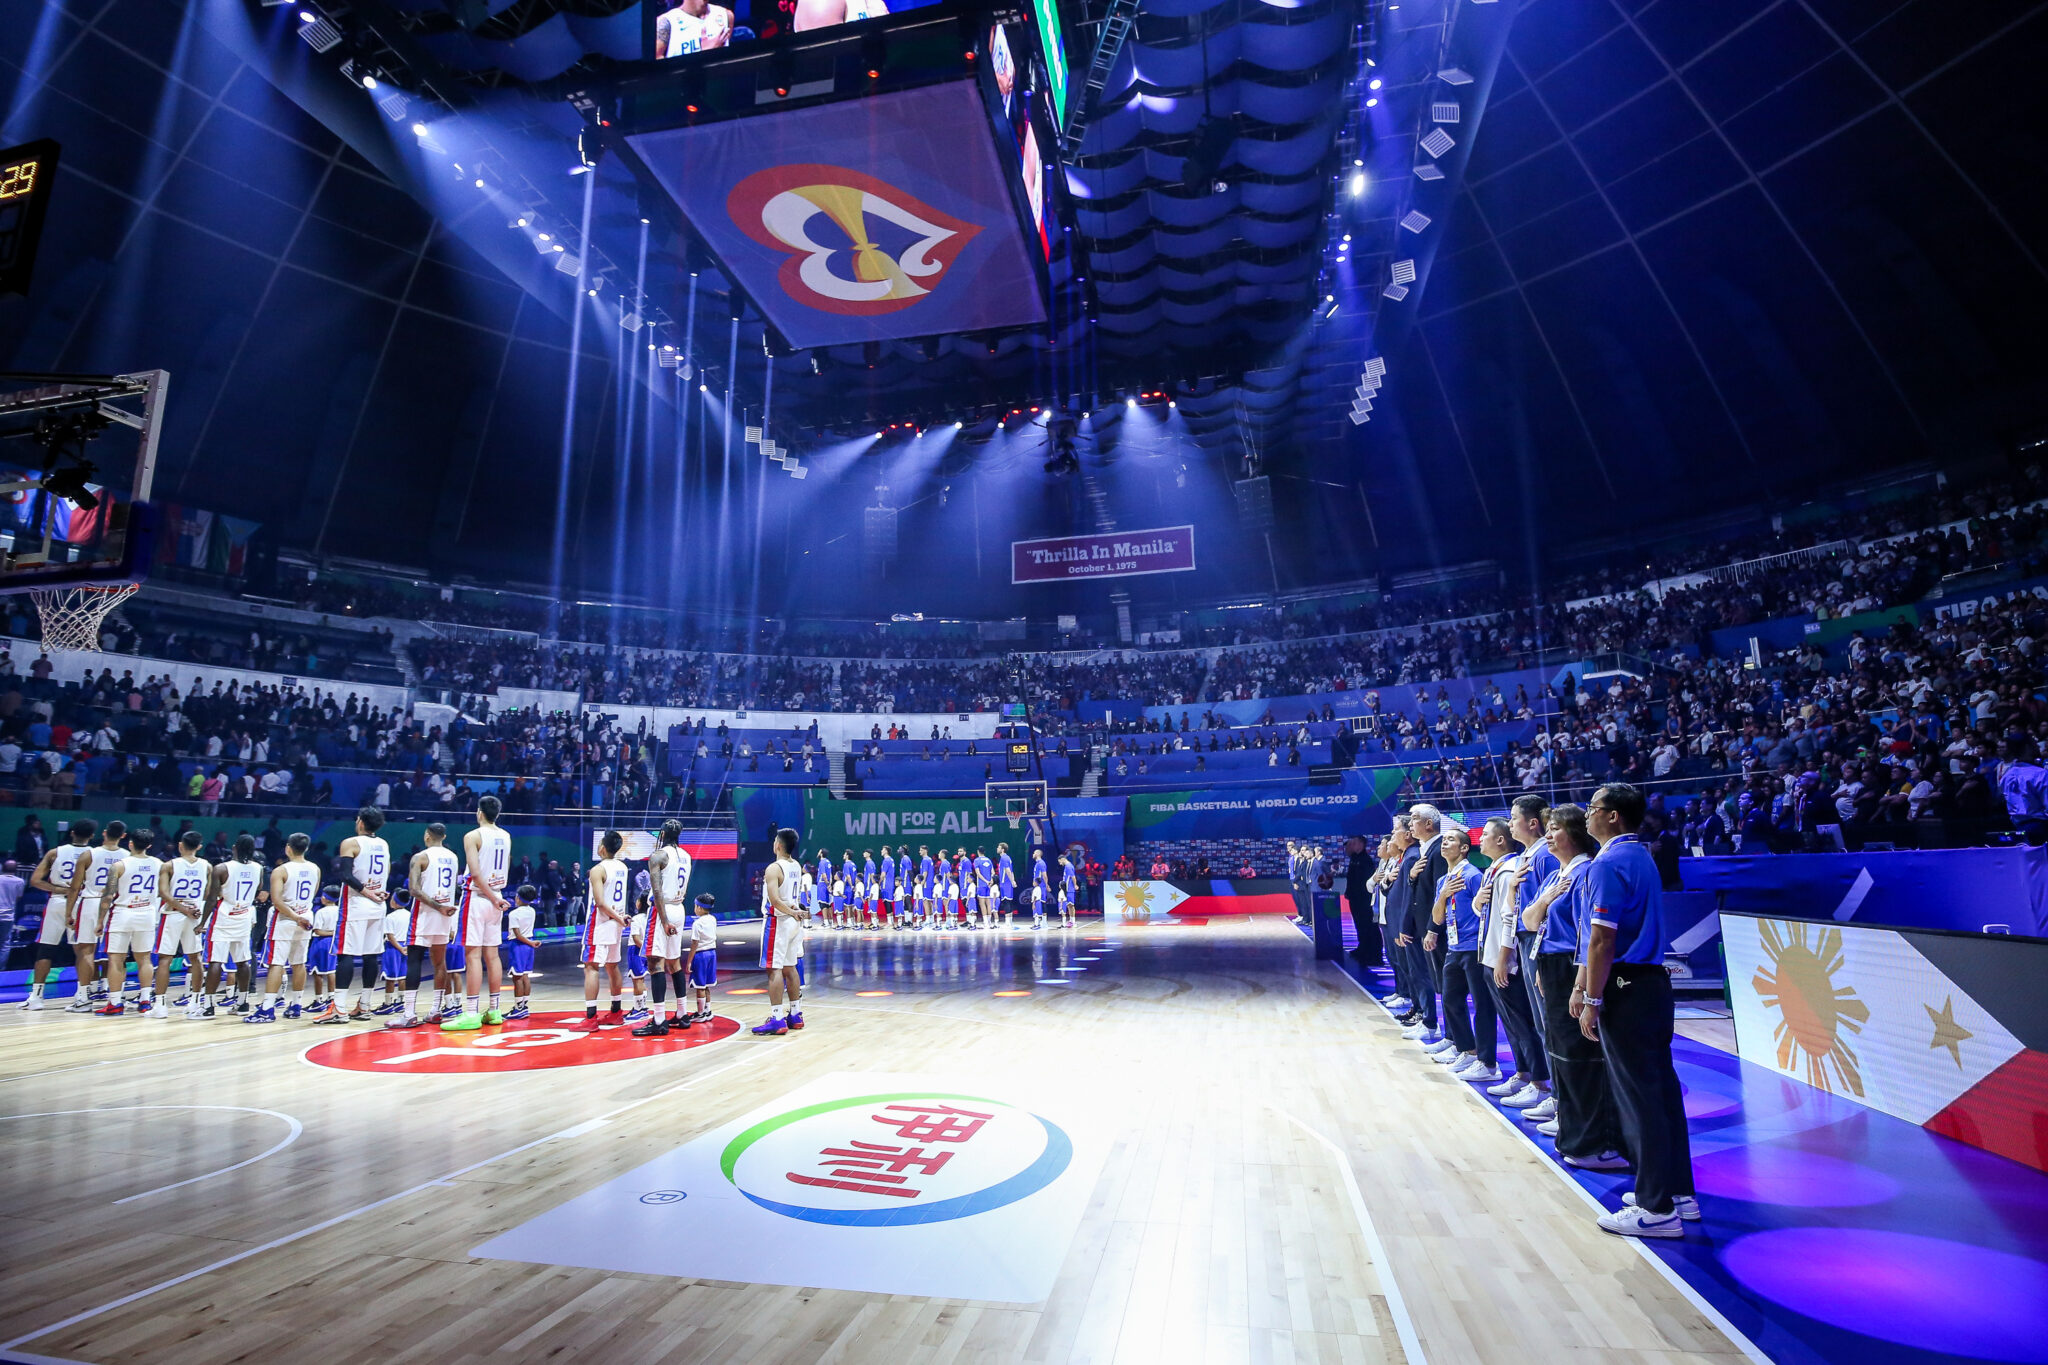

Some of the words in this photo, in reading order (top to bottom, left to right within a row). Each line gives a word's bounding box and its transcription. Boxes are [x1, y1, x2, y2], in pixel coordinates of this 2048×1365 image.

[1026, 548, 1088, 564] "Thrilla
[1092, 545, 1110, 560] In
[1113, 540, 1178, 557] Manila"
[1068, 564, 1105, 574] October
[1107, 563, 1114, 572] 1,
[1116, 561, 1137, 570] 1975
[1150, 803, 1175, 812] FIBA
[1177, 801, 1251, 811] BASKETBALL
[1256, 798, 1297, 808] WORLD
[1300, 796, 1324, 806] CUP
[1326, 795, 1358, 804] 2023
[845, 812, 896, 835] WIN
[902, 812, 935, 826] FOR
[940, 811, 993, 834] ALL
[368, 854, 384, 875] 15
[494, 849, 503, 870] 11
[60, 861, 75, 879] 3
[95, 867, 109, 886] 2
[438, 867, 452, 888] 13
[678, 867, 686, 888] 6
[128, 874, 155, 893] 24
[173, 878, 202, 898] 23
[236, 881, 253, 901] 17
[296, 880, 311, 900] 16
[613, 880, 623, 902] 8
